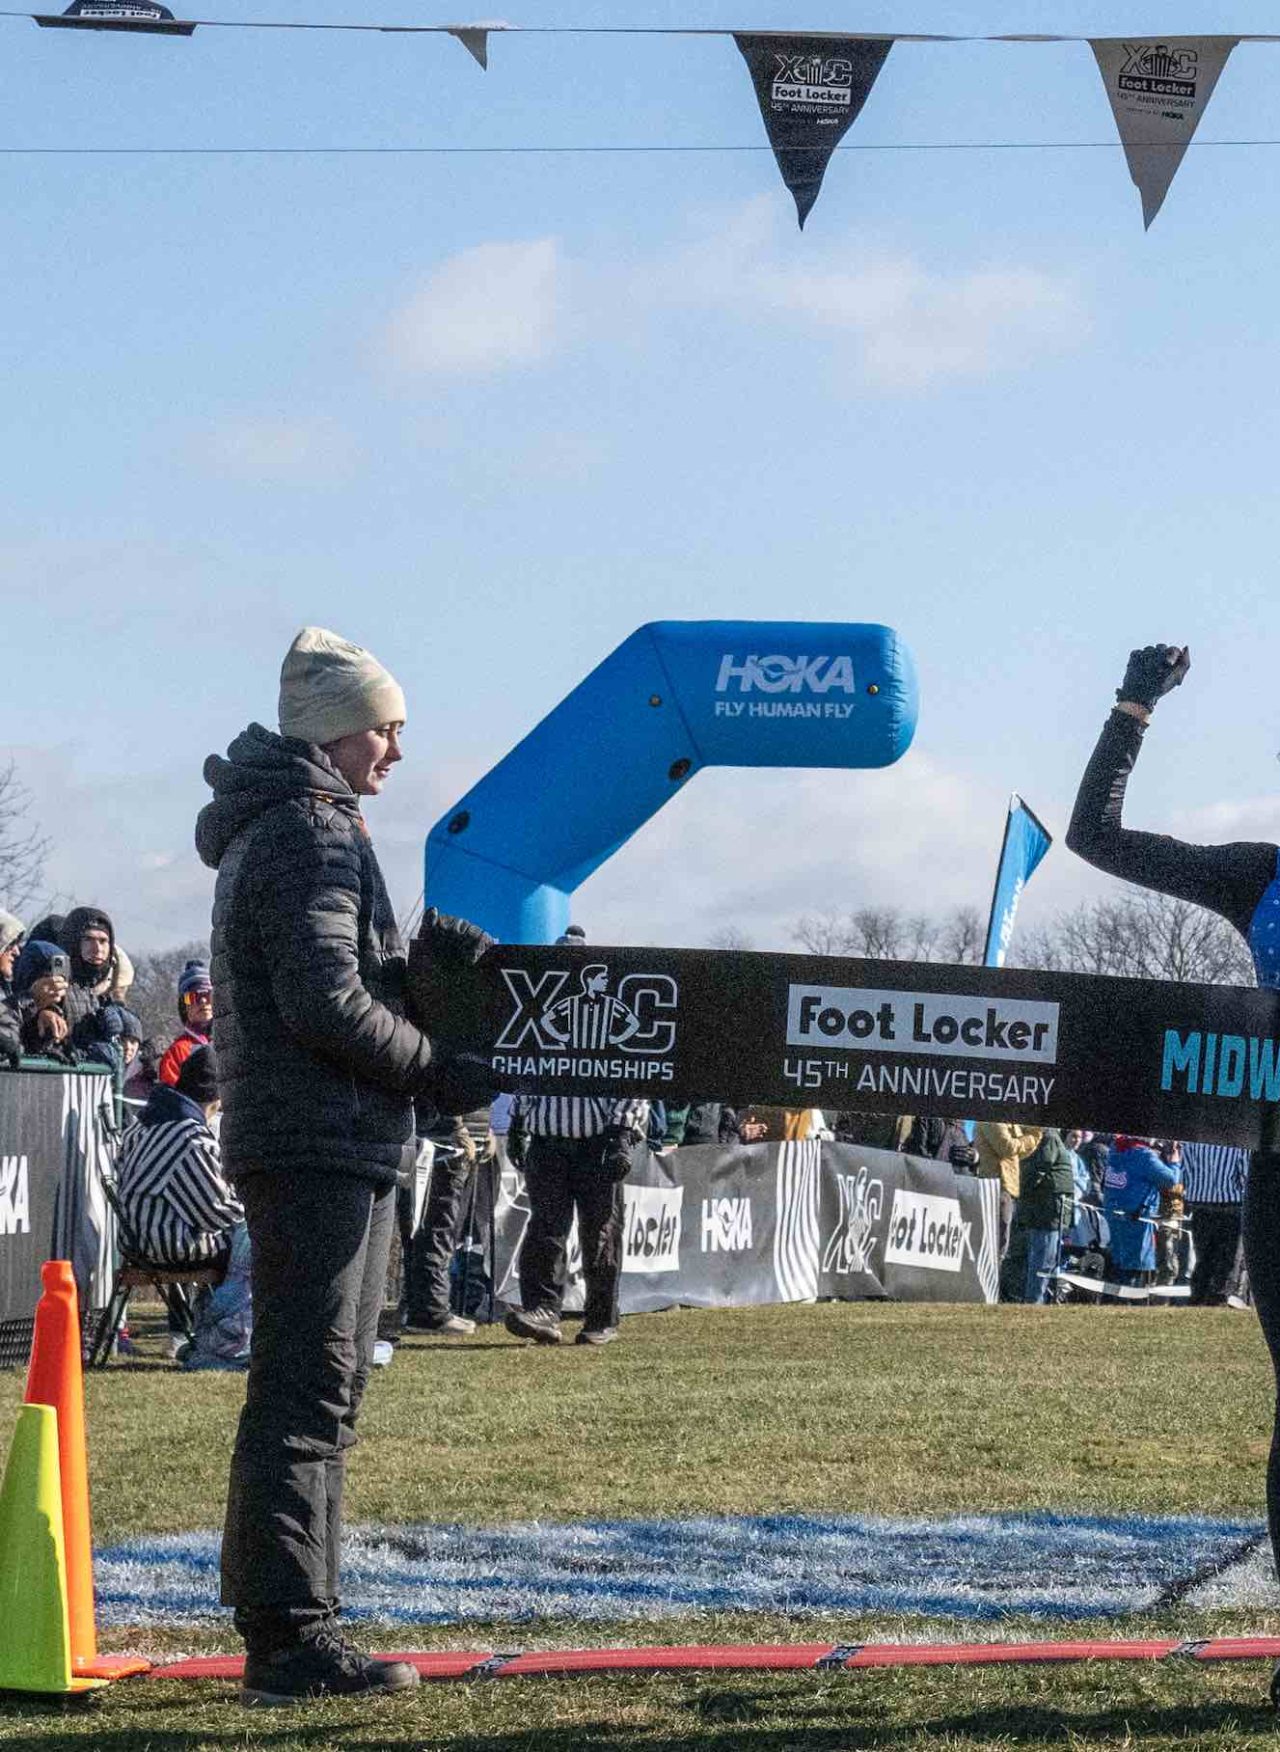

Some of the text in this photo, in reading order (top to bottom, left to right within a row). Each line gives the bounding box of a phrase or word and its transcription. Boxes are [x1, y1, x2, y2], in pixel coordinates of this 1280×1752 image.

[775, 86, 847, 101] Foot Locker
[1121, 77, 1193, 95] Foot Locker
[715, 654, 855, 693] HOKA
[715, 701, 854, 719] FLY HUMAN FLY
[799, 995, 1049, 1050] Foot Locker
[492, 1056, 675, 1080] CHAMPIONSHIPS
[783, 1058, 1055, 1105] 45TH ANNIVERSARY
[0, 1155, 31, 1235] KA
[701, 1197, 752, 1252] HOKA
[919, 1207, 962, 1258] Locker
